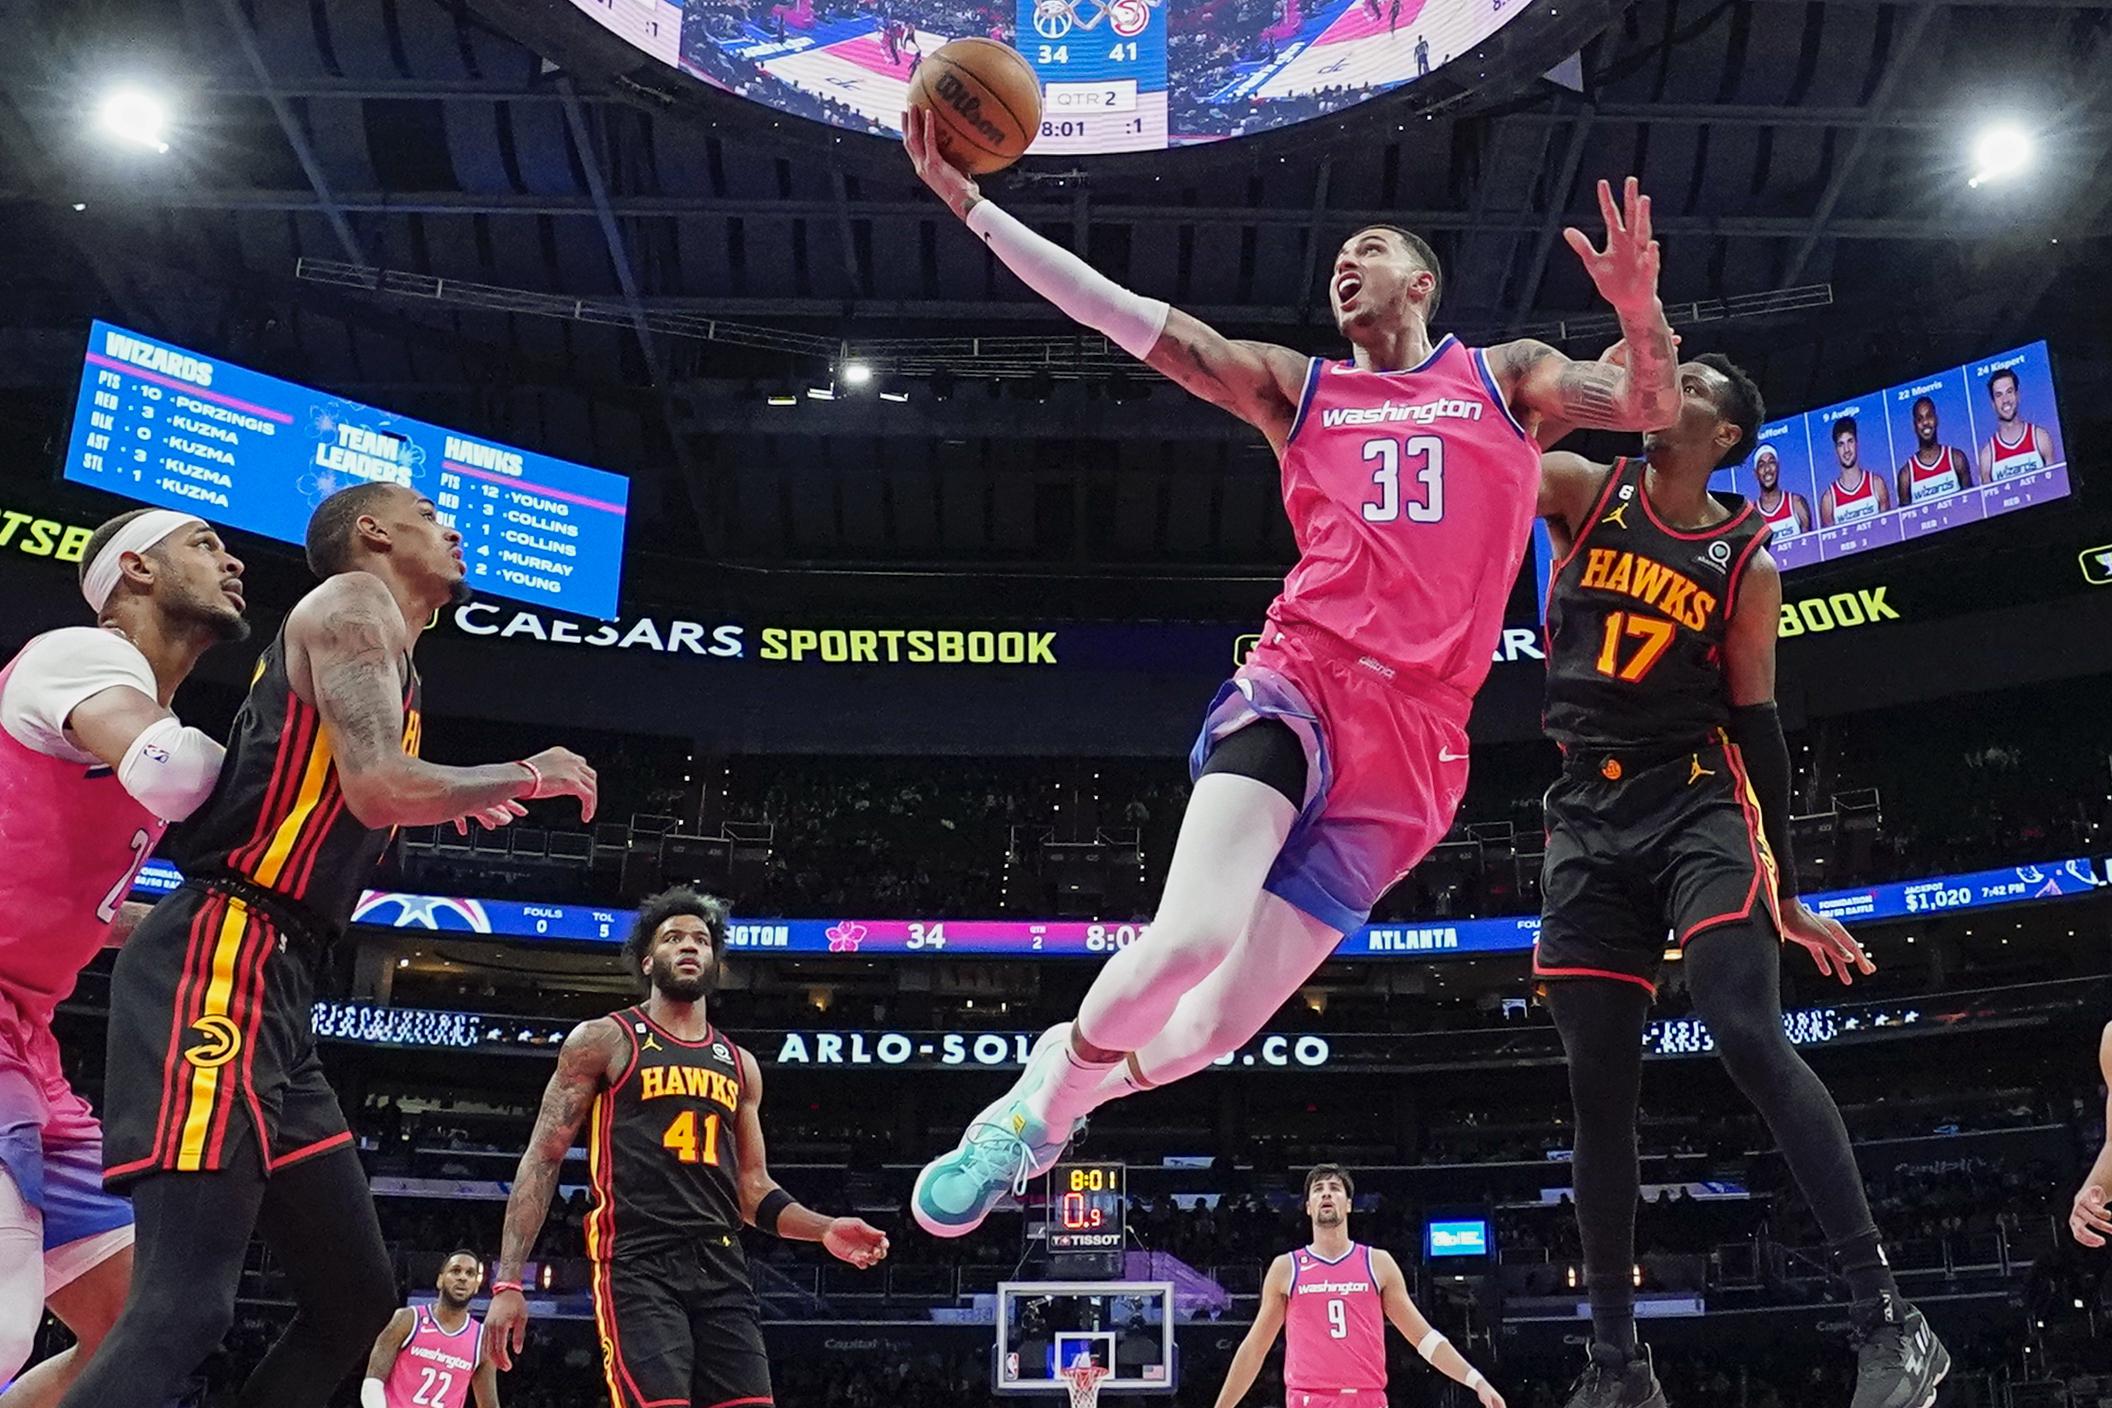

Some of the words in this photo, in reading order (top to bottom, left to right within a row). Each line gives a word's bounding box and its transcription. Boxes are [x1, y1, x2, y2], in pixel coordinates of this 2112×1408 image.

[1037, 44, 1069, 64] 34
[1108, 42, 1138, 62] 41
[935, 69, 1006, 147] Wilson
[1057, 92, 1099, 106] QTR
[1104, 91, 1117, 106] 2
[1041, 121, 1085, 137] 8:01
[105, 331, 214, 387] WIZARDS
[1976, 364, 1990, 377] 24
[1990, 354, 2025, 373] Kispert
[98, 370, 121, 390] PTS
[140, 384, 163, 401] 10
[175, 396, 276, 436] PORZINGIS
[1897, 389, 1910, 401] 22
[1911, 380, 1943, 397] Morris
[94, 390, 119, 411] REB
[141, 405, 155, 419] 3
[172, 415, 240, 445] KUZMA
[90, 411, 115, 432] BLK
[136, 426, 152, 441] 0
[168, 435, 236, 466] KUZMA
[336, 423, 401, 463] TEAM
[86, 432, 111, 452] AST
[133, 448, 148, 463] 3
[165, 457, 233, 489] KUZMA
[315, 442, 414, 488] LEADERS
[444, 435, 524, 477] HAWKS
[82, 452, 104, 473] STL
[132, 469, 142, 482] 1
[161, 477, 229, 508] KUZMA
[1361, 434, 1445, 524] 33
[1618, 484, 1635, 500] 6
[1984, 486, 2000, 498] PTS
[2019, 475, 2036, 487] AST
[440, 472, 462, 491] PTS
[480, 483, 500, 499] 12
[511, 491, 570, 517] YOUNG
[1902, 509, 1918, 520] PTS
[1936, 499, 1953, 511] AST
[437, 491, 460, 510] REB
[482, 504, 495, 517] 3
[507, 510, 579, 537] COLLINS
[482, 524, 491, 536] 1
[505, 529, 577, 557] COLLINS
[1822, 530, 1838, 542] PTS
[1855, 520, 1873, 532] AST
[477, 544, 490, 557] 4
[502, 550, 574, 577] MURRAY
[1777, 541, 1793, 552] AST
[475, 563, 488, 576] 2
[501, 568, 562, 593] YOUNG
[1579, 547, 1717, 632] HAWKS
[454, 602, 743, 657] CAESARS
[759, 627, 1058, 664] SPORTSBOOK
[1596, 611, 1677, 684] 17
[1904, 882, 1944, 895] JACKPOT
[1905, 887, 1972, 913] $1,020
[1981, 885, 2008, 898] 7:42
[2008, 882, 2026, 895] PM
[523, 906, 563, 919] FOULS
[536, 919, 548, 934] 0
[592, 911, 615, 923] TOL
[599, 924, 610, 938] 5
[906, 923, 946, 950] 34
[1032, 935, 1043, 950] 2
[1368, 927, 1458, 950] ATLANTA
[640, 1065, 739, 1112] HAWKS
[663, 1110, 720, 1167] 41
[1070, 1169, 1116, 1191] 8:01
[1064, 1192, 1101, 1229] 0.9
[1071, 1234, 1121, 1246] TISSOT
[1327, 1298, 1348, 1340] 9
[412, 1366, 453, 1408] 22
